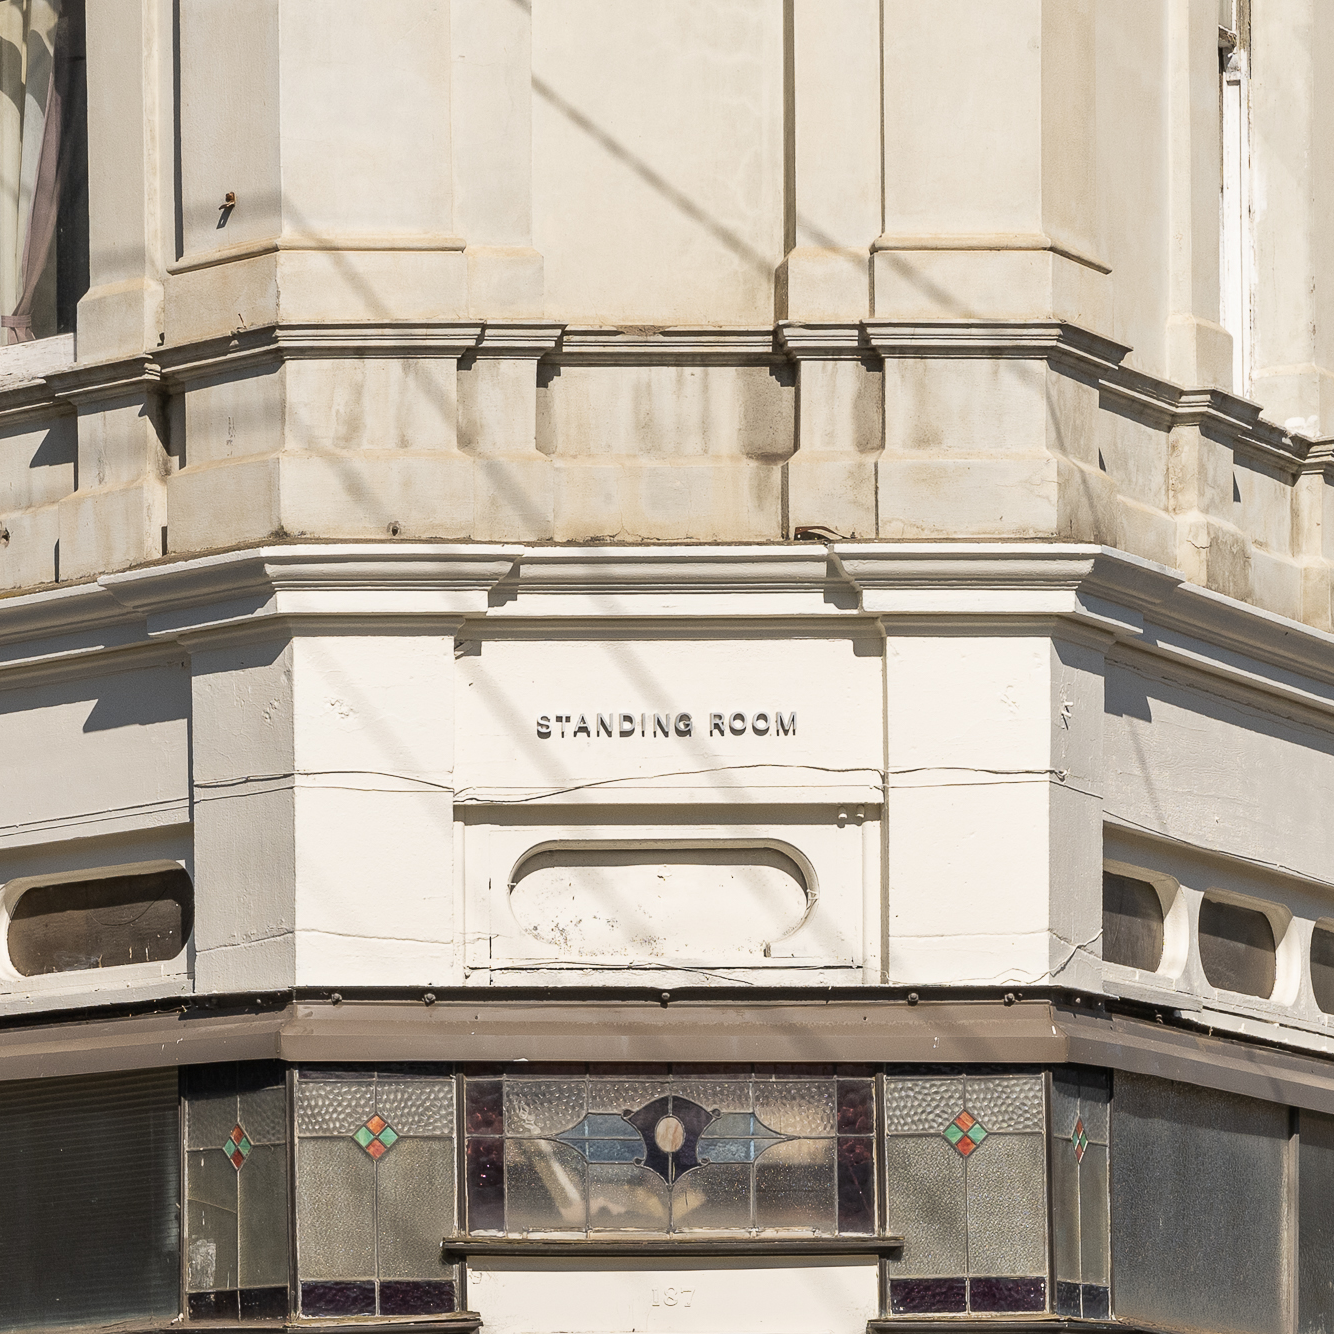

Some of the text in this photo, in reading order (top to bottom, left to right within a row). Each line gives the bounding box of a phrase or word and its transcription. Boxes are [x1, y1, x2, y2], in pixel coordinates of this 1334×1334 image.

[535, 710, 799, 738] STANDING ROOM
[651, 1287, 696, 1308] 187
